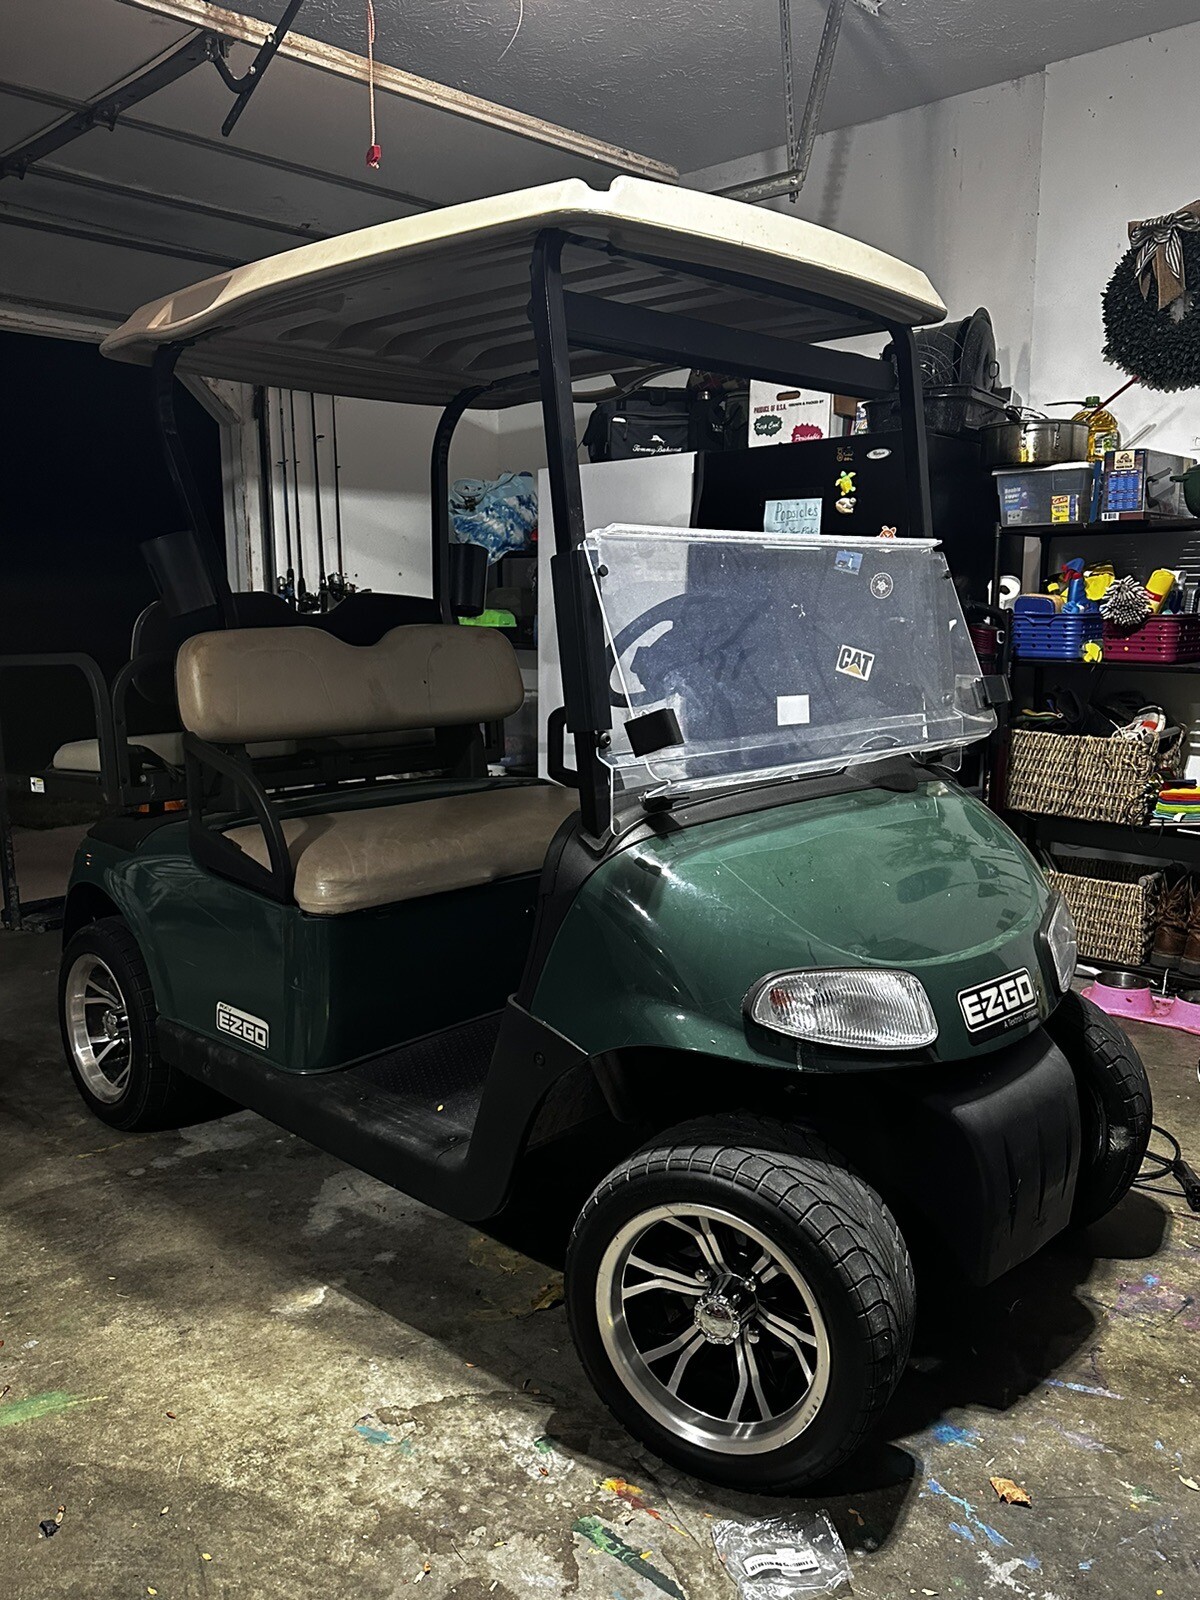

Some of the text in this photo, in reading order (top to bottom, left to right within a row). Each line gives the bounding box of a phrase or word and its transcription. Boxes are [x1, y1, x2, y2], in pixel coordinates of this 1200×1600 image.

[754, 405, 770, 413] PRODUCE
[632, 443, 682, 455] Tommy Bahama
[775, 502, 818, 525] Popsicles
[838, 647, 873, 677] CAT
